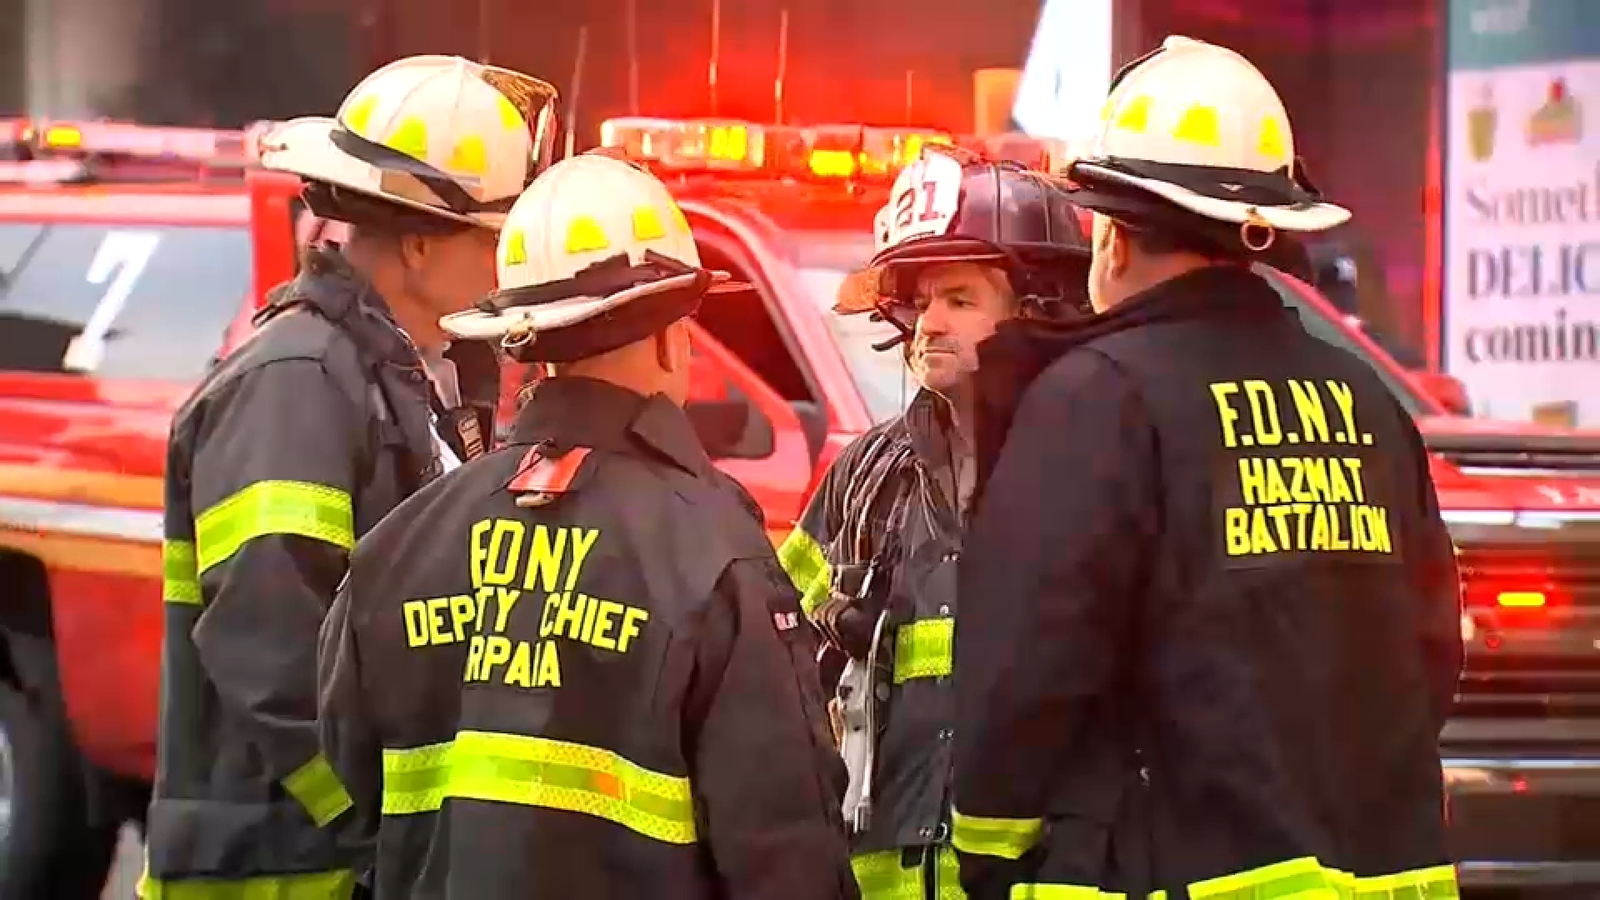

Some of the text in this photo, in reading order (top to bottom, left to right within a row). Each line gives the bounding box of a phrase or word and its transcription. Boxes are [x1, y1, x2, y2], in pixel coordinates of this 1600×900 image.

[1466, 162, 1600, 222] Somet
[62, 231, 161, 371] 7
[1209, 379, 1373, 448] F.D.N.Y.
[1238, 457, 1364, 505] HAZMAT
[1225, 503, 1393, 556] BATTALION
[539, 590, 649, 653] CHIEF
